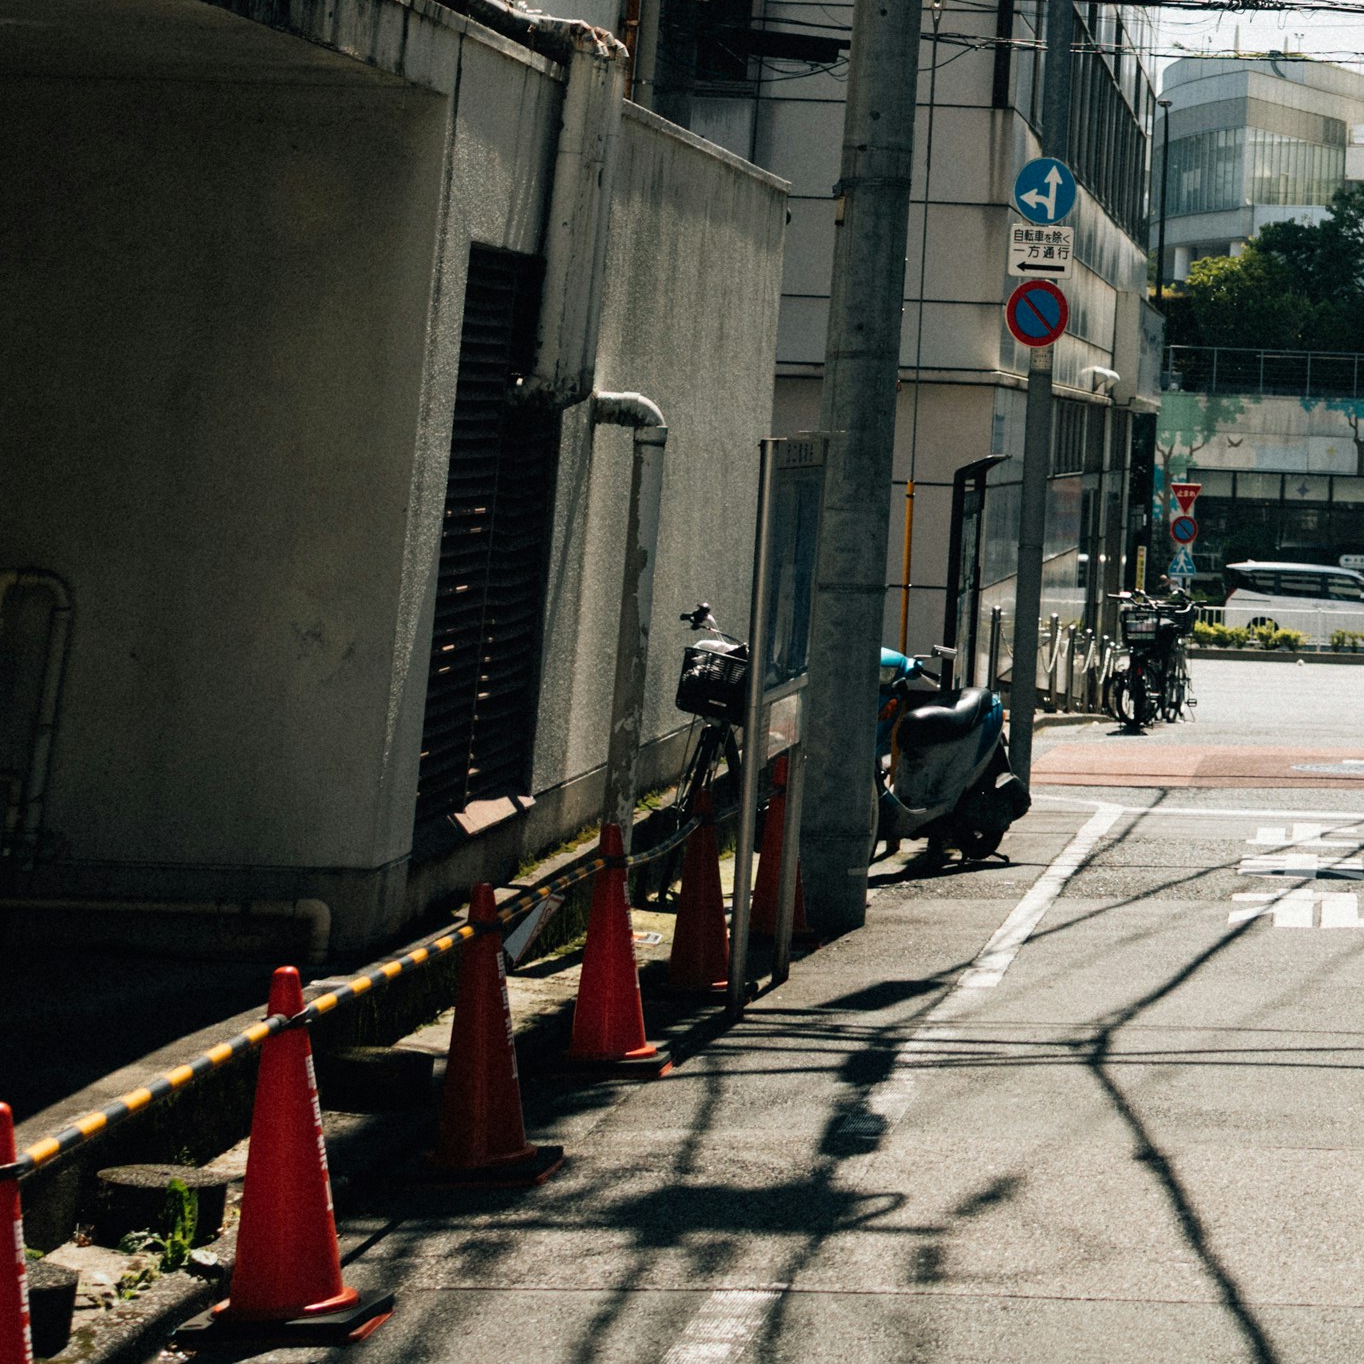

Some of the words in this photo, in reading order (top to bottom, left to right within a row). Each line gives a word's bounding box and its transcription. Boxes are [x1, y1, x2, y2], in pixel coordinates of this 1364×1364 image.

[1013, 228, 1071, 244] 自転車を除く
[1013, 245, 1070, 260] 一方通行
[1177, 489, 1196, 498] 止まれ
